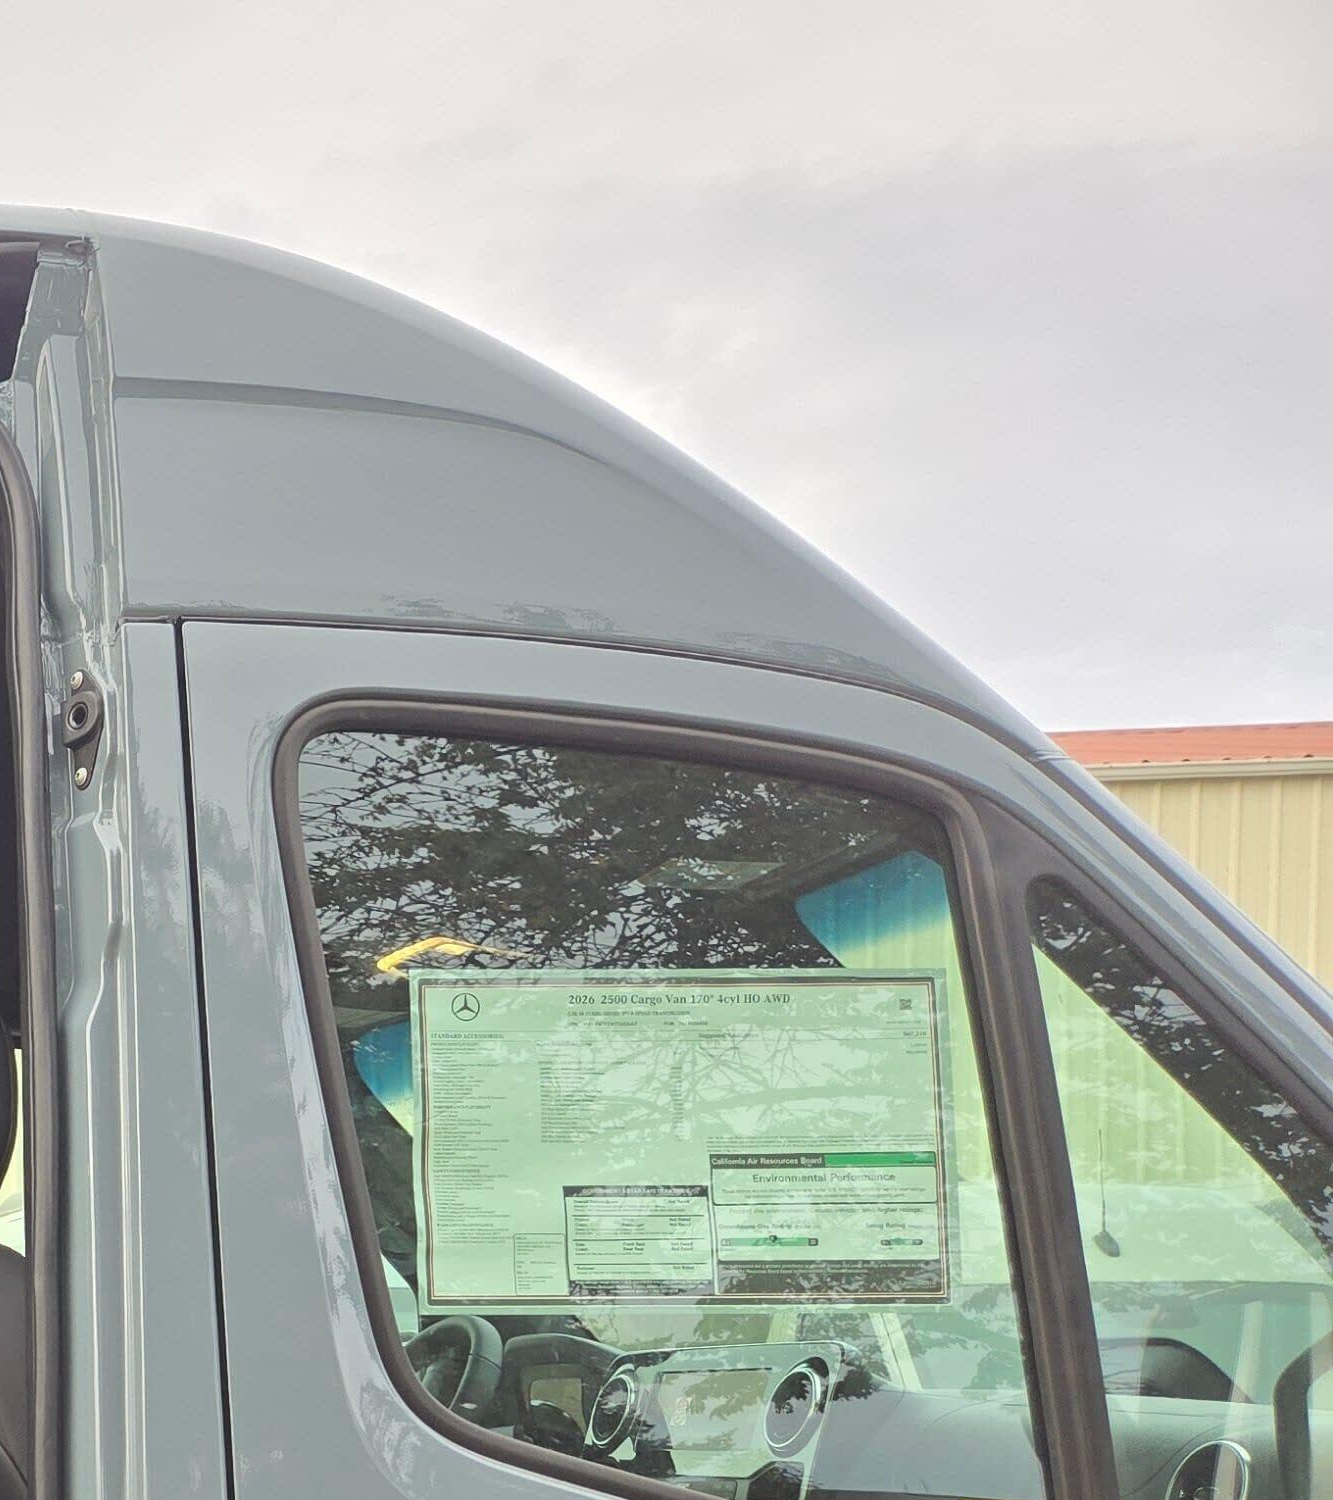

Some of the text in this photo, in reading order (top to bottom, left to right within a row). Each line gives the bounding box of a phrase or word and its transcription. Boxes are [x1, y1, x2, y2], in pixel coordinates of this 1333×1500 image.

[568, 994, 595, 1005] 2026
[600, 994, 628, 1005] 2500
[630, 994, 663, 1007] Cargo
[665, 994, 687, 1005] Van
[717, 993, 740, 1006] 4cyl
[743, 993, 761, 1004] HO
[764, 993, 791, 1004] AWD
[712, 1157, 746, 1165] California
[800, 1156, 822, 1164] Board
[752, 1172, 896, 1183] Environmental Performance
